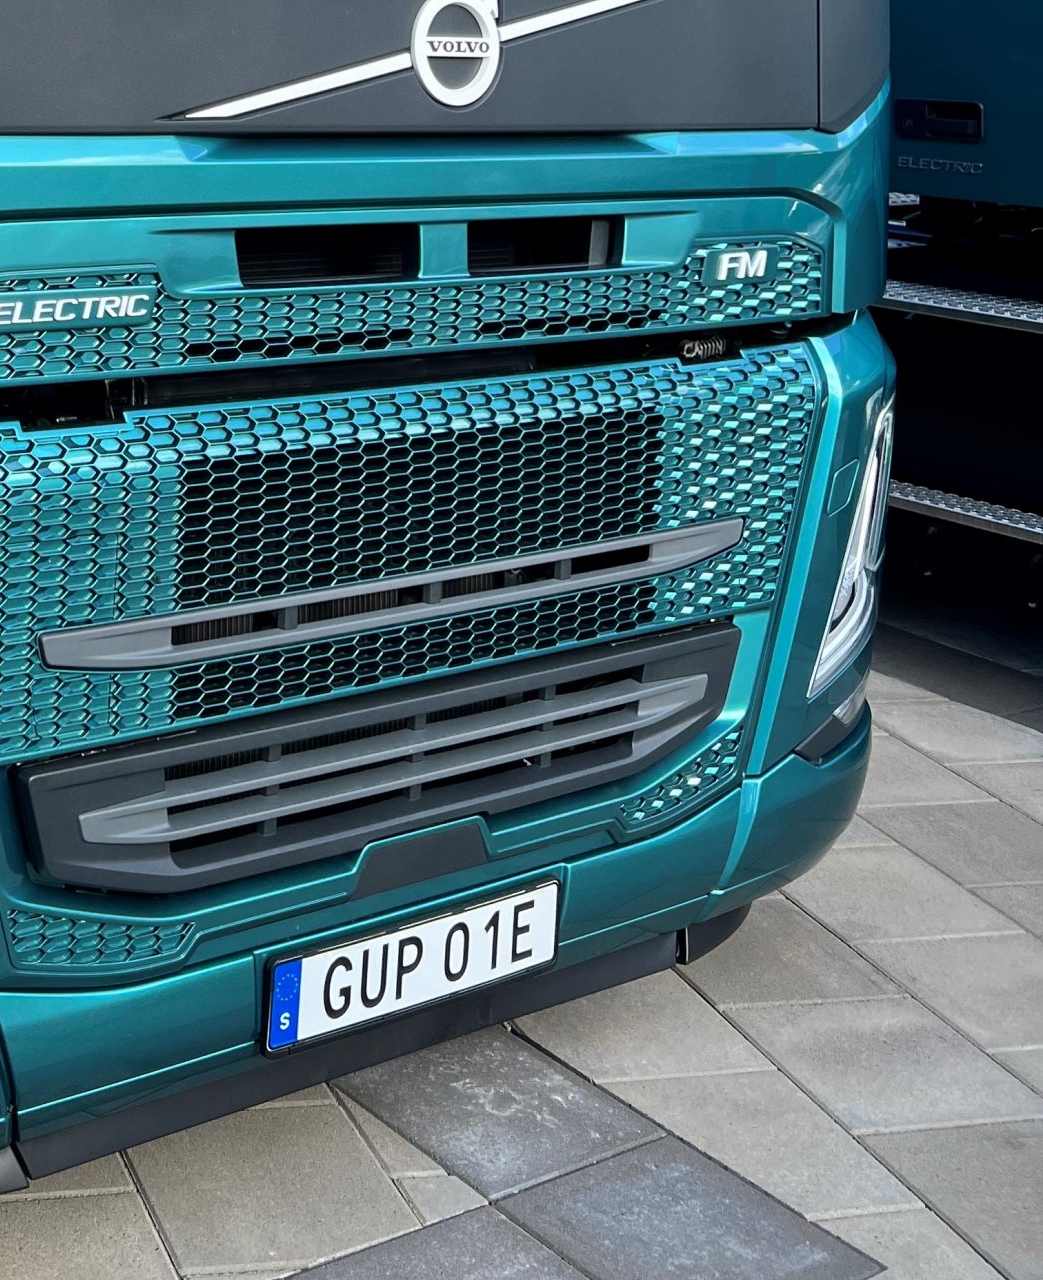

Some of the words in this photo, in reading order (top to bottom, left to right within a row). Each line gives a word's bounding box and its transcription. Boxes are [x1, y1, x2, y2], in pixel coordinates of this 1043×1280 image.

[426, 40, 489, 53] VOLVO
[897, 156, 983, 174] ELECTRIC
[716, 249, 768, 281] FM
[323, 935, 423, 1019] GUP
[444, 899, 535, 982] 01E
[279, 1012, 290, 1031] S
